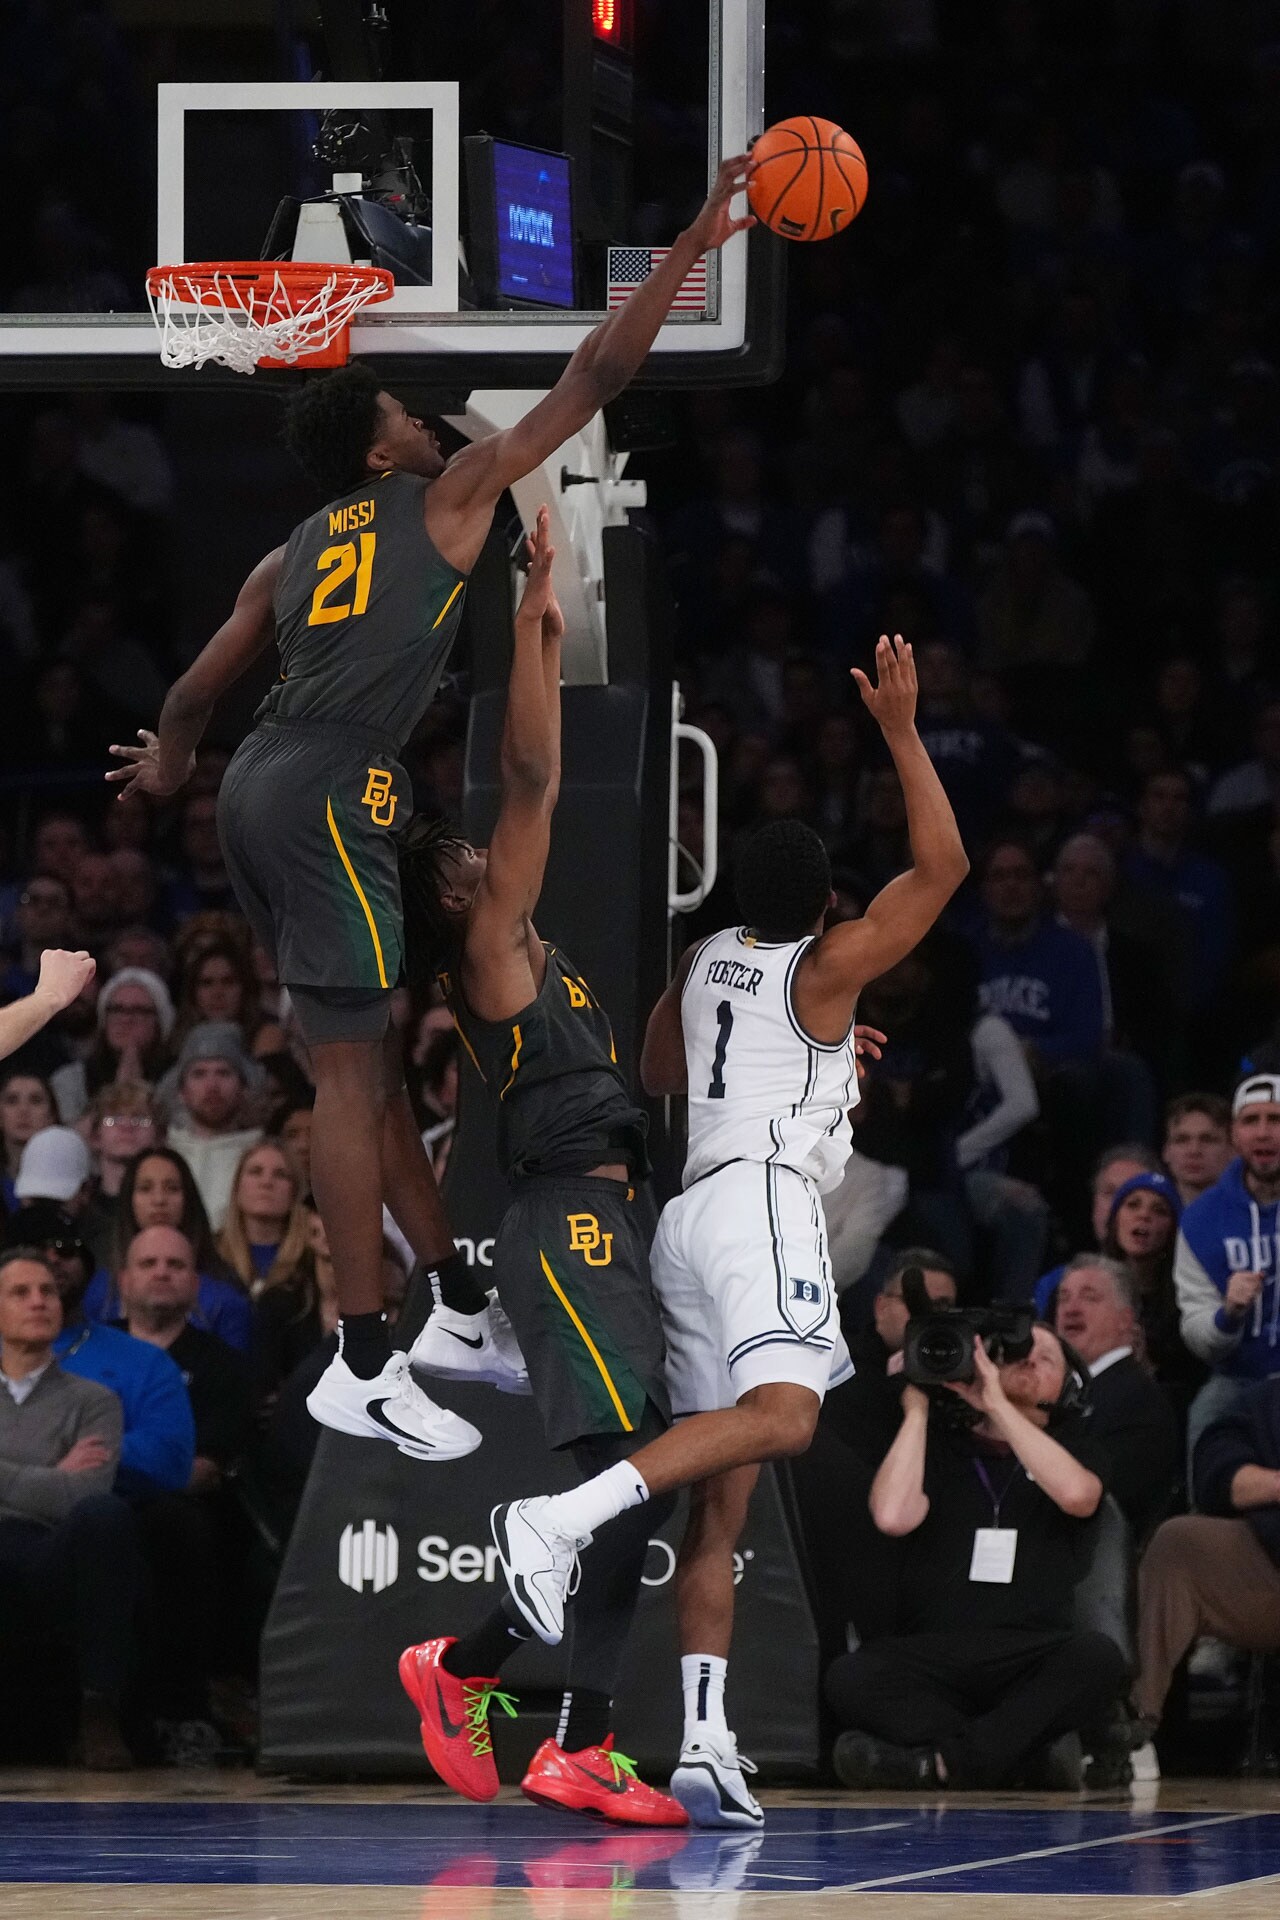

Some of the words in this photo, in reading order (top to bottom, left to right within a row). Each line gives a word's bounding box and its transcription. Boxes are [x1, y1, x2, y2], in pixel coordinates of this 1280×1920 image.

[329, 500, 375, 537] MISSI
[308, 532, 376, 626] 21
[361, 768, 397, 826] BU
[704, 960, 764, 996] FOSTER
[708, 1000, 733, 1099] 1
[567, 1213, 613, 1266] BU
[1222, 1233, 1280, 1271] DU
